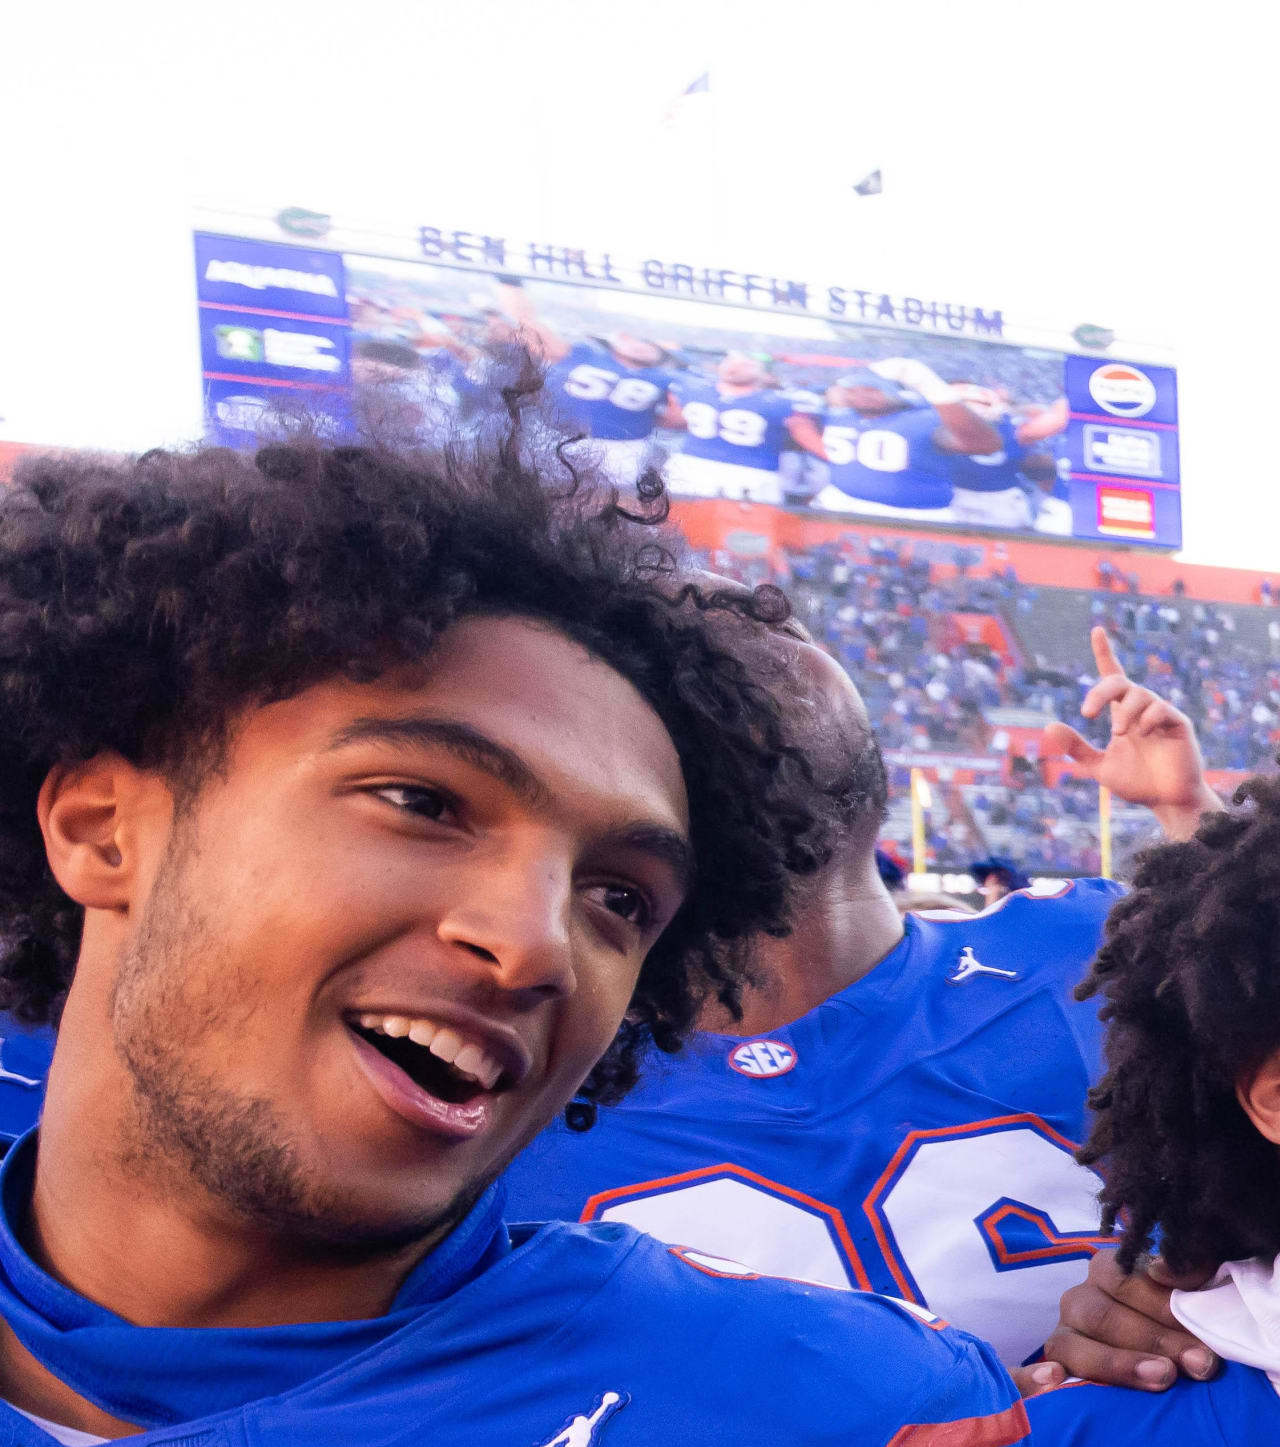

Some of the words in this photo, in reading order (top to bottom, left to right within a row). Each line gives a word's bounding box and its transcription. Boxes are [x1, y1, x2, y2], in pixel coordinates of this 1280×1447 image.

[418, 225, 505, 266] BEN
[529, 242, 622, 282] HILL
[642, 259, 807, 309] GRIFFIN
[827, 285, 1003, 337] STADIUM
[822, 424, 908, 473] 50
[734, 1040, 796, 1075] SEC
